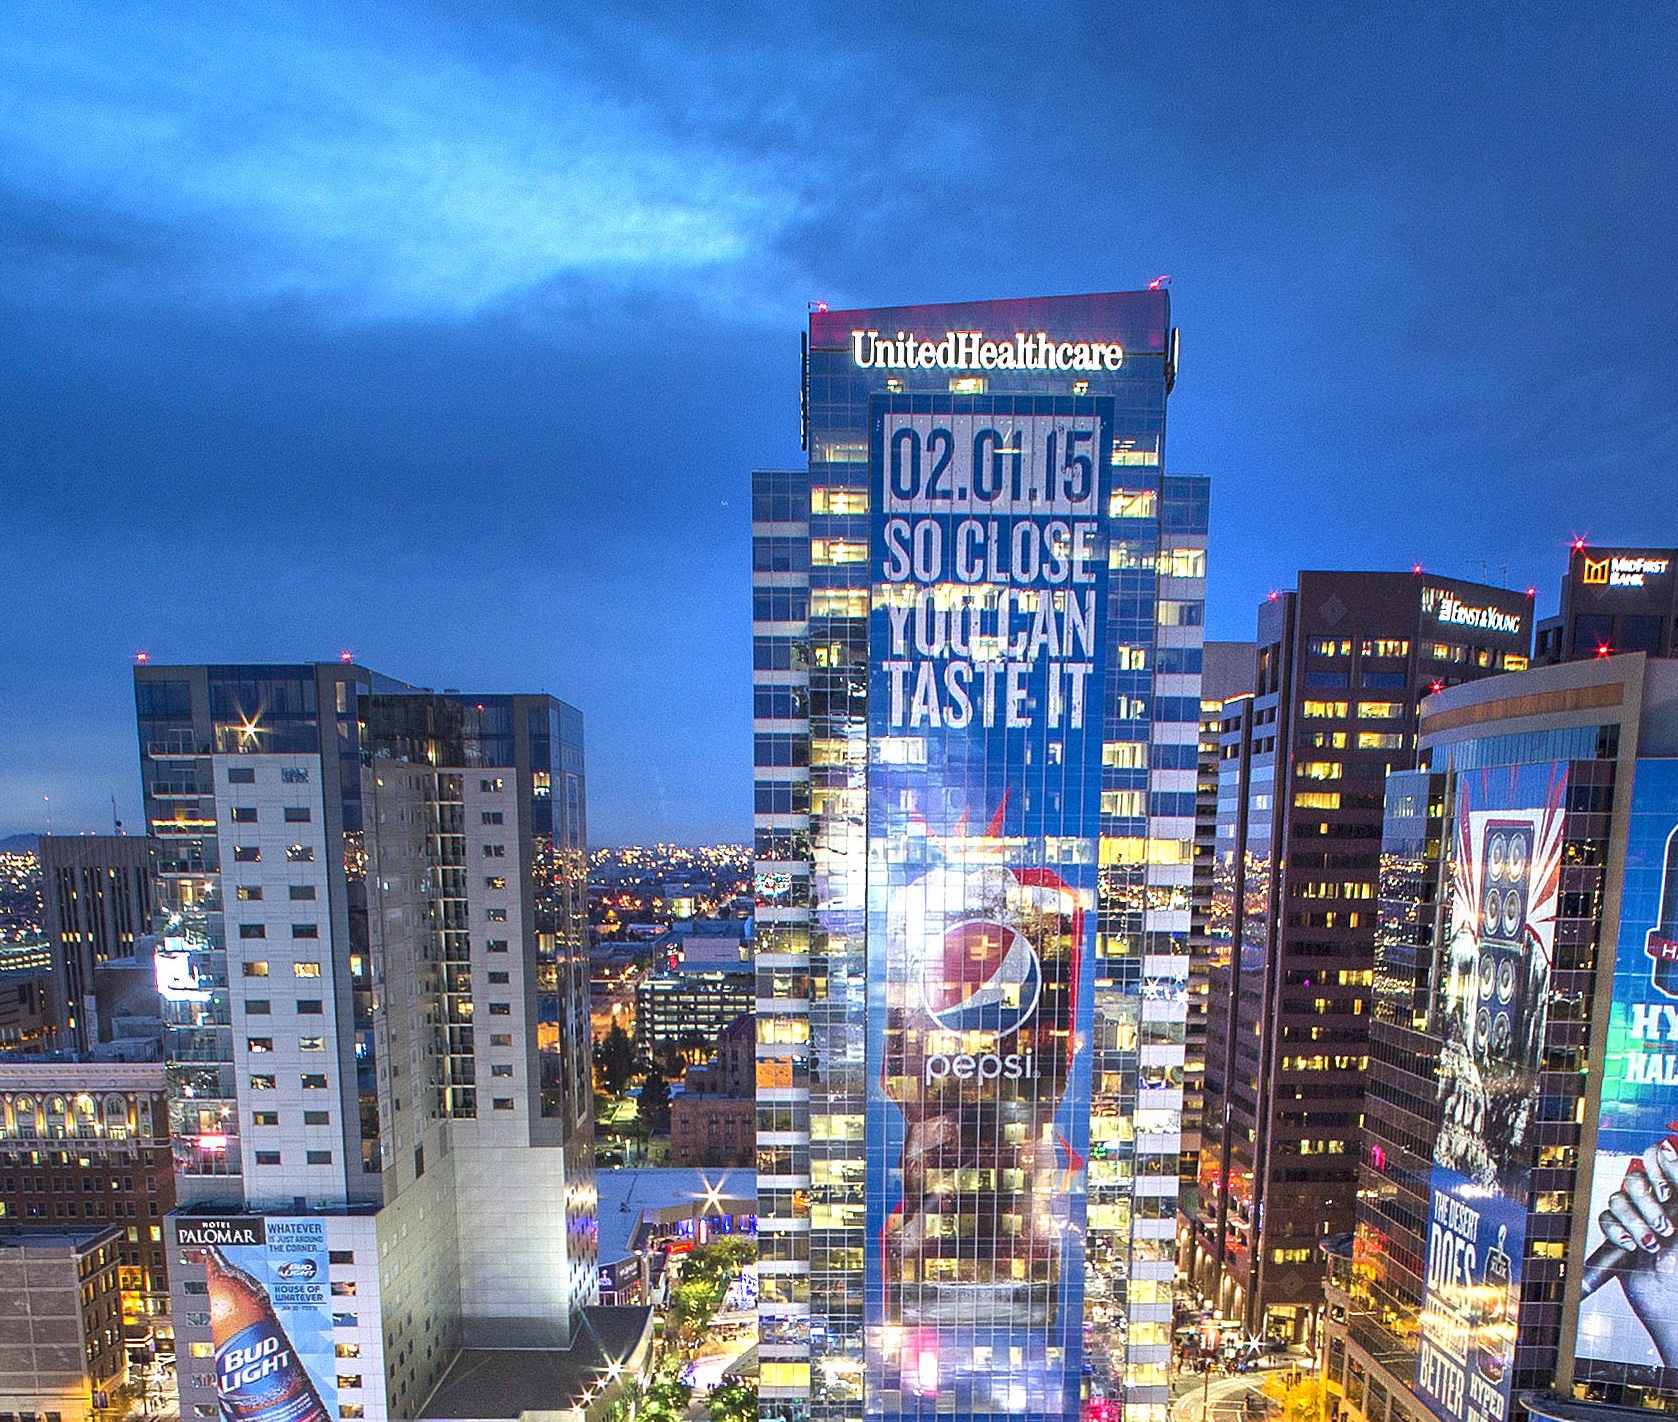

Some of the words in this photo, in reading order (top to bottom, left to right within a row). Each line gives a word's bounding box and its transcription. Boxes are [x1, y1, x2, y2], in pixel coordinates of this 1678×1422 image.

[851, 330, 1123, 371] UnitedHealthcare
[891, 427, 1093, 503] 02.01.15
[883, 520, 941, 582] SO
[956, 522, 1098, 583] CLOSE
[883, 662, 1032, 728] TASTE
[1048, 662, 1093, 728] IT
[926, 1047, 1032, 1086] pepsi
[178, 1229, 256, 1244] PALOMAR
[267, 1223, 322, 1234] WHATEVER
[1434, 1190, 1449, 1228] THE
[1449, 1196, 1480, 1243] DESERT
[274, 1285, 305, 1293] HOUSE
[307, 1285, 321, 1293] OF
[1427, 1222, 1476, 1317] DOES
[274, 1293, 324, 1302] WHATEVER
[221, 1350, 289, 1394] LIGHT
[224, 1336, 279, 1373] BUD
[1419, 1341, 1466, 1420] BETTER
[1469, 1371, 1505, 1422] HYPED
